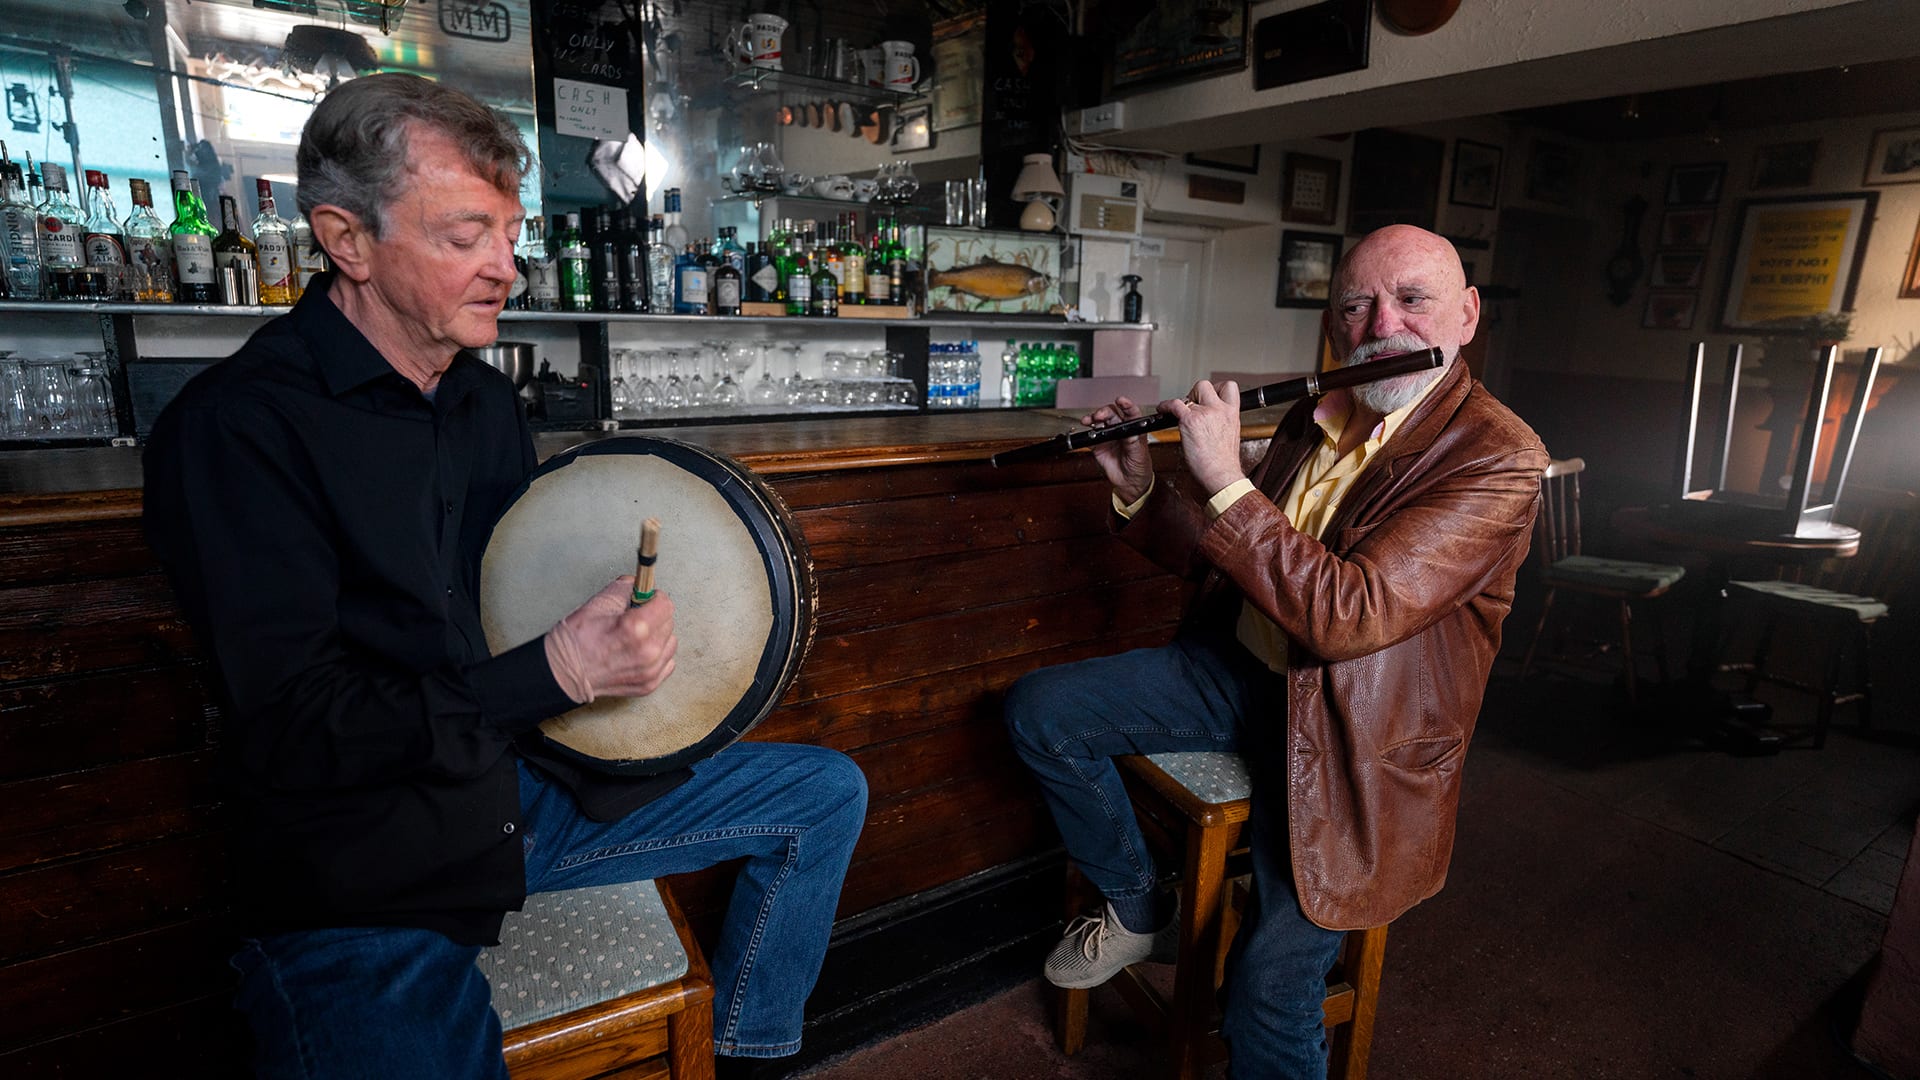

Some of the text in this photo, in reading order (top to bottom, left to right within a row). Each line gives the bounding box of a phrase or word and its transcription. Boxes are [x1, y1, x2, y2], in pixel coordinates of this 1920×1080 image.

[569, 33, 615, 52] ONLY
[557, 84, 610, 105] CASH
[570, 105, 597, 116] ONLY
[6, 212, 24, 254] DINGLE
[259, 243, 286, 252] PADDY
